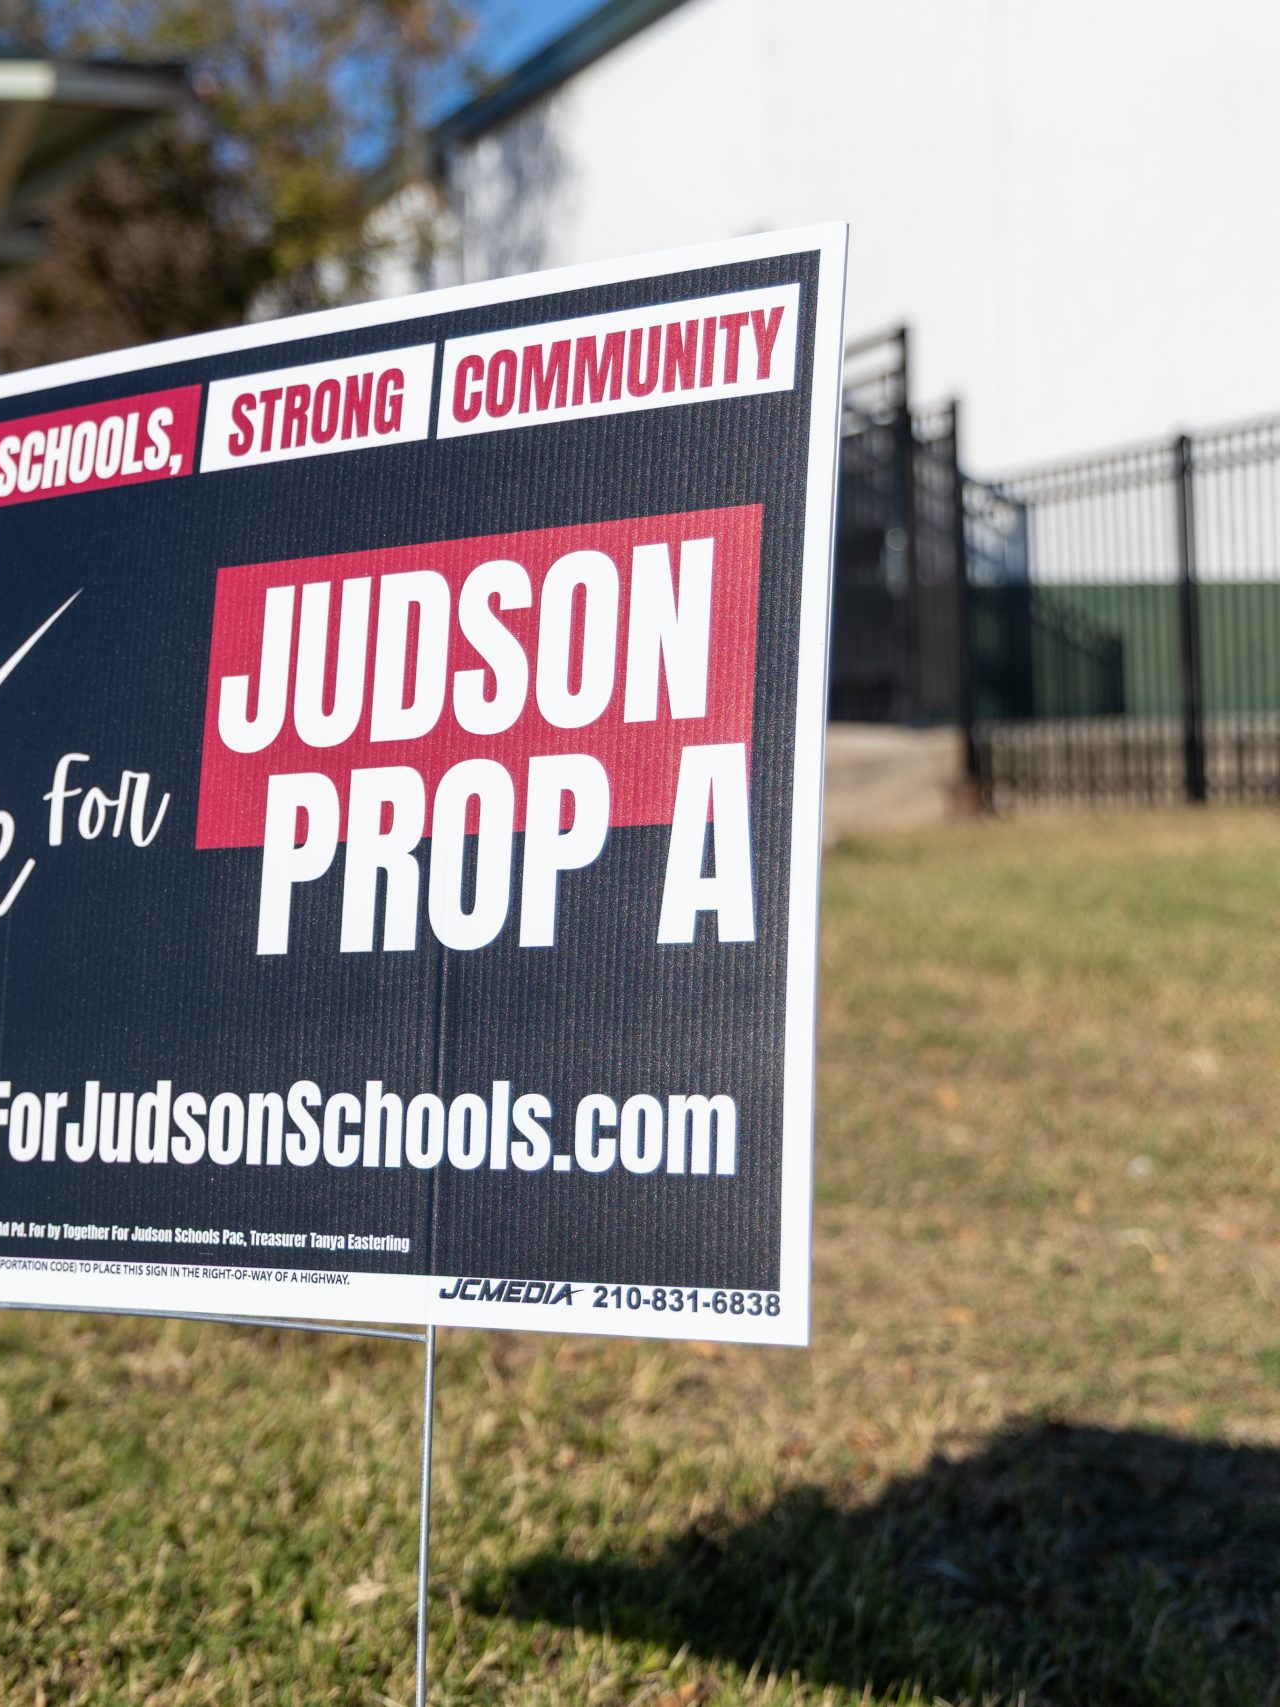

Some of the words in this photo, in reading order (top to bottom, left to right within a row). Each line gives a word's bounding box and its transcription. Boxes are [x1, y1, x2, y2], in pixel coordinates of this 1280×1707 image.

[228, 367, 405, 457] STRONG
[452, 306, 785, 423] COMMUNITY
[217, 537, 715, 753] JUDSON
[43, 753, 170, 847] for
[256, 753, 610, 955] PROP
[657, 742, 755, 944] A
[11, 1222, 27, 1237] Pd.
[29, 1222, 46, 1238] For
[47, 1223, 61, 1240] by
[63, 1223, 110, 1241] Together
[111, 1225, 130, 1241] For
[131, 1226, 172, 1242] Judson
[174, 1227, 220, 1244] Schools
[222, 1229, 247, 1247] Pac,
[250, 1230, 307, 1247] Treasurer
[310, 1232, 345, 1250] Tanya
[347, 1233, 410, 1253] Easterling
[50, 1261, 77, 1273] CODE)
[80, 1262, 91, 1273] TO
[93, 1263, 121, 1274] PLACE
[124, 1264, 143, 1275] THIS
[145, 1265, 168, 1277] SIGN
[170, 1266, 180, 1277] IN
[182, 1267, 200, 1278] THE
[202, 1268, 273, 1281] RIGHT-OF-WAY
[275, 1271, 289, 1282] OF
[291, 1272, 298, 1282] A
[300, 1272, 350, 1285] HIGHWAY.
[439, 1278, 584, 1305] JCMEDIA
[593, 1285, 780, 1317] 210-831-6838
